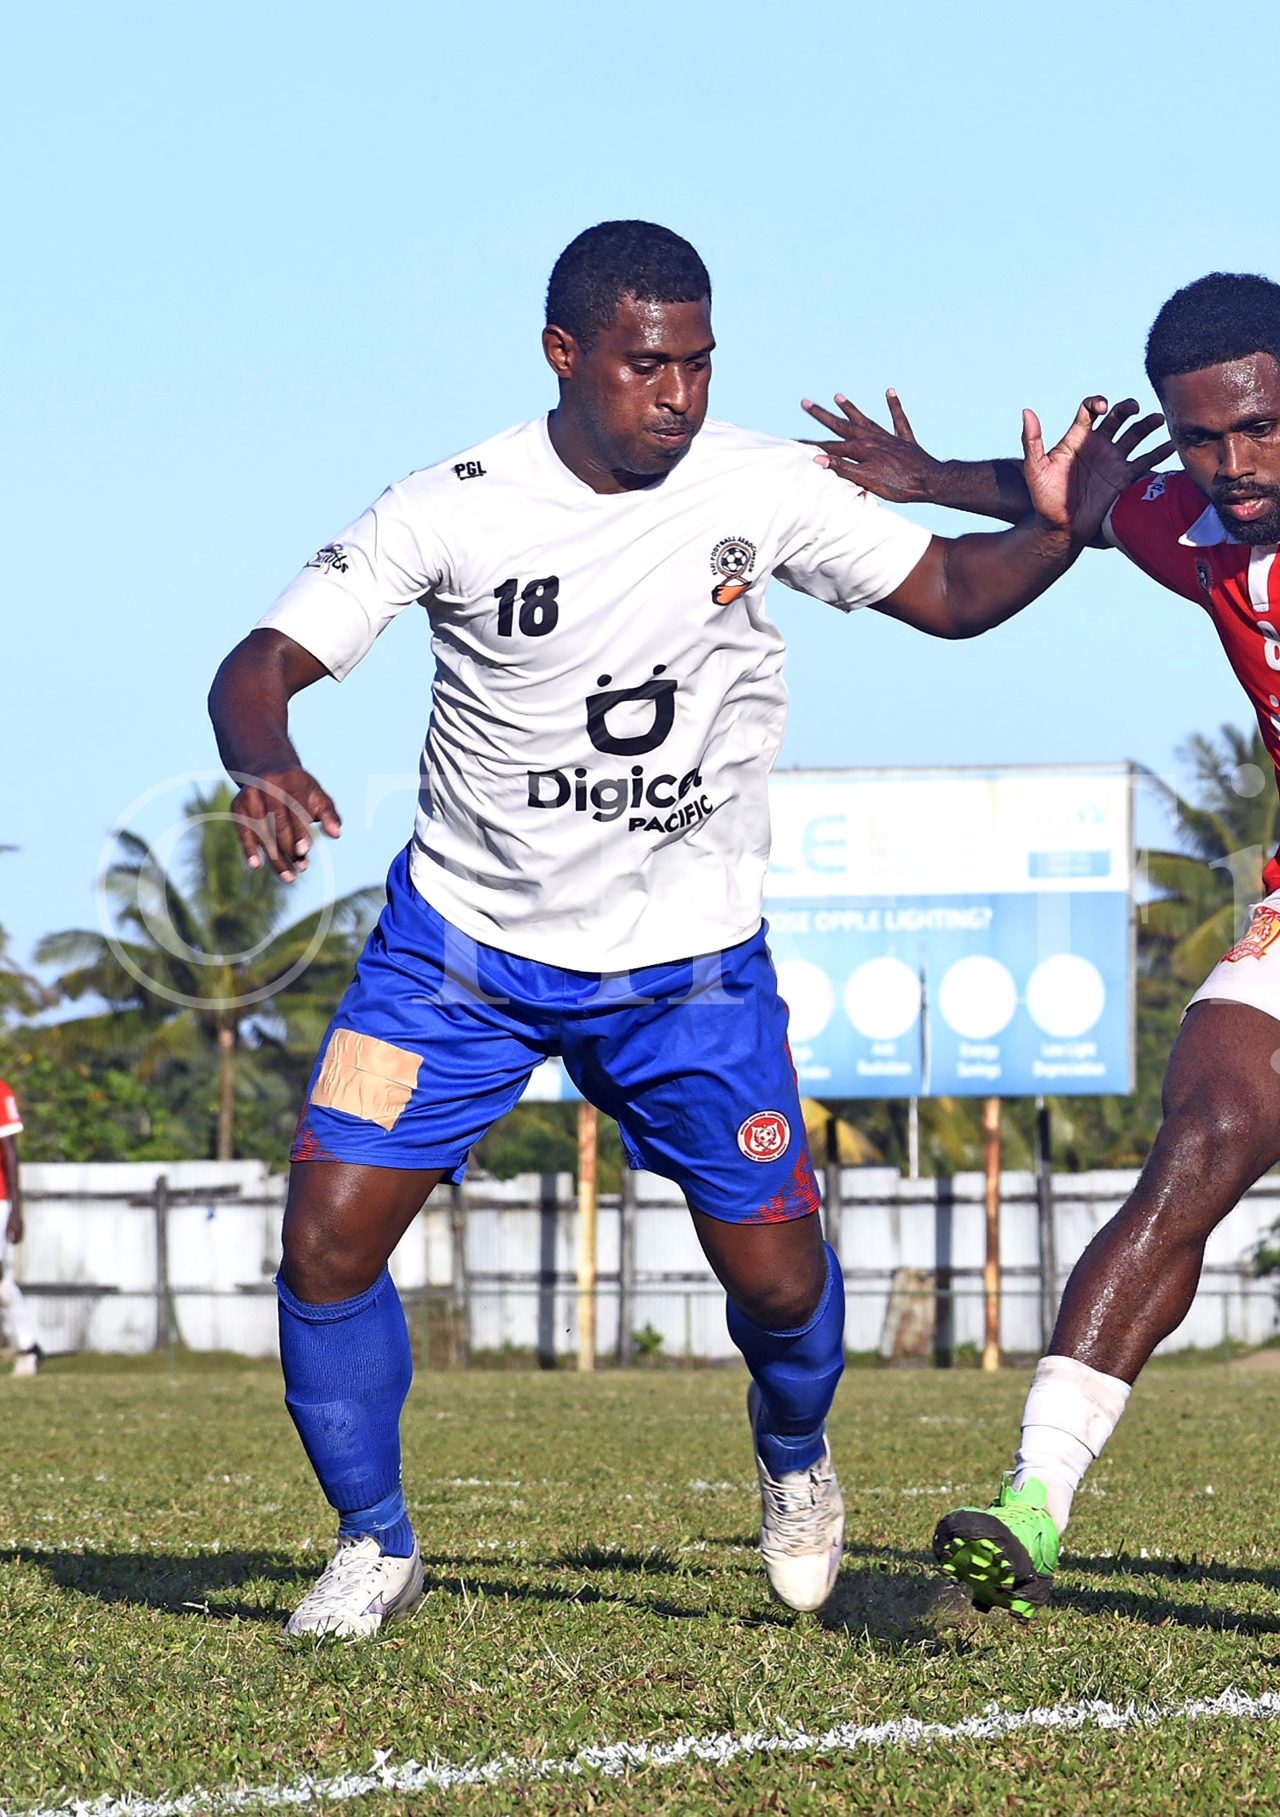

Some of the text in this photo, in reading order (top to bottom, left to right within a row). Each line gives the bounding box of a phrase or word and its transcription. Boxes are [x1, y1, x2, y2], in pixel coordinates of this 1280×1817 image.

[453, 460, 487, 480] PGL
[493, 575, 560, 637] 18
[527, 764, 703, 823] Digice
[628, 794, 713, 833] PACIFIC
[815, 909, 881, 931] OPPLE
[885, 907, 994, 930] LIGHTING?
